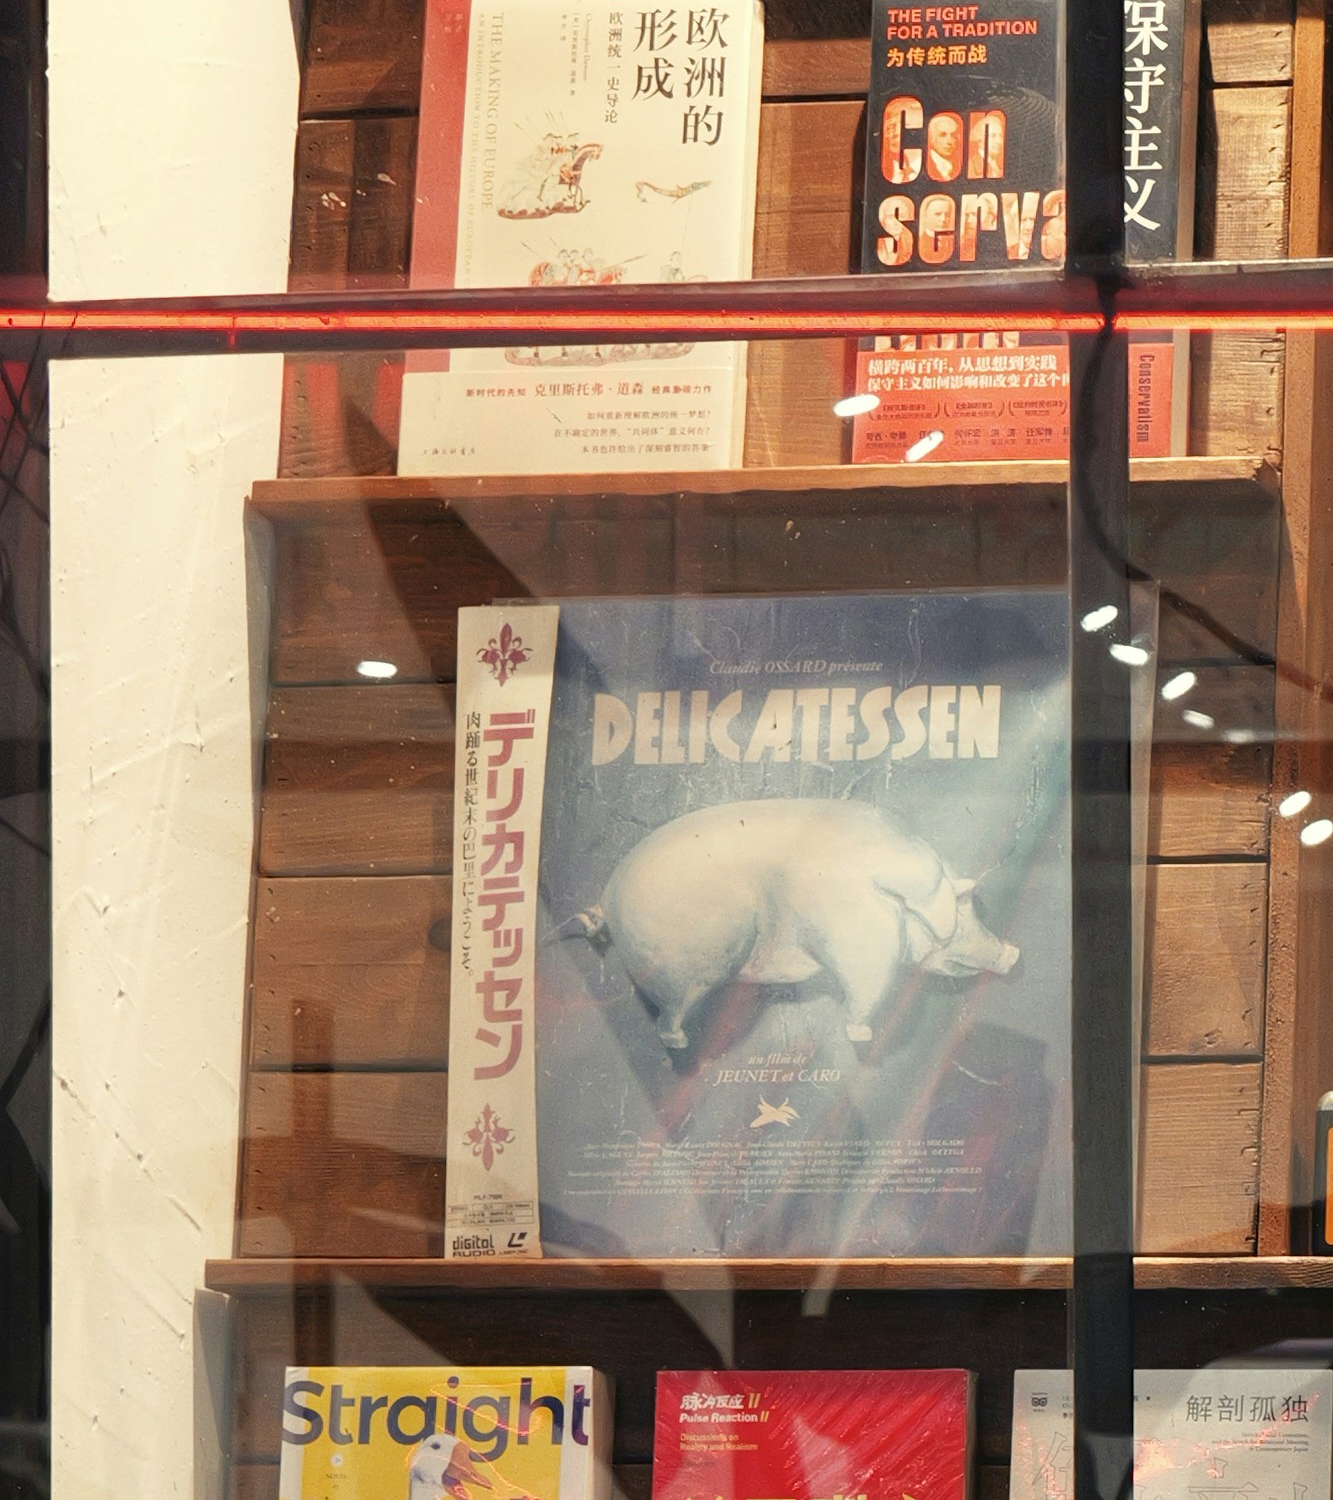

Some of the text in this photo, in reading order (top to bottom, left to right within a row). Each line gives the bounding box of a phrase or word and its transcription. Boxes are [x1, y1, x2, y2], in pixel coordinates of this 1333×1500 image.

[631, 8, 678, 102] 形成
[886, 43, 988, 67] 为传统而战
[887, 19, 1038, 41] FOR A TRADITION
[888, 5, 979, 23] THE FIGHT
[603, 10, 625, 126] 欧洲统一史导论
[681, 7, 731, 147] 欧洲的
[480, 12, 505, 211] THE MAKING OF EUROPE
[880, 95, 1008, 184] Con
[533, 380, 645, 398] 克里斯托弗·道森
[1136, 353, 1157, 443] Conservatism
[709, 658, 828, 675] Claudie OSSARD
[591, 684, 1001, 766] DELICATESSEN
[472, 707, 536, 1081] デリカテッセン
[713, 1067, 842, 1085] JEUNET CARO
[281, 1374, 591, 1464] Straight
[679, 1410, 759, 1424] Pulse Reaction
[1185, 1393, 1310, 1424] 解剖孤独
